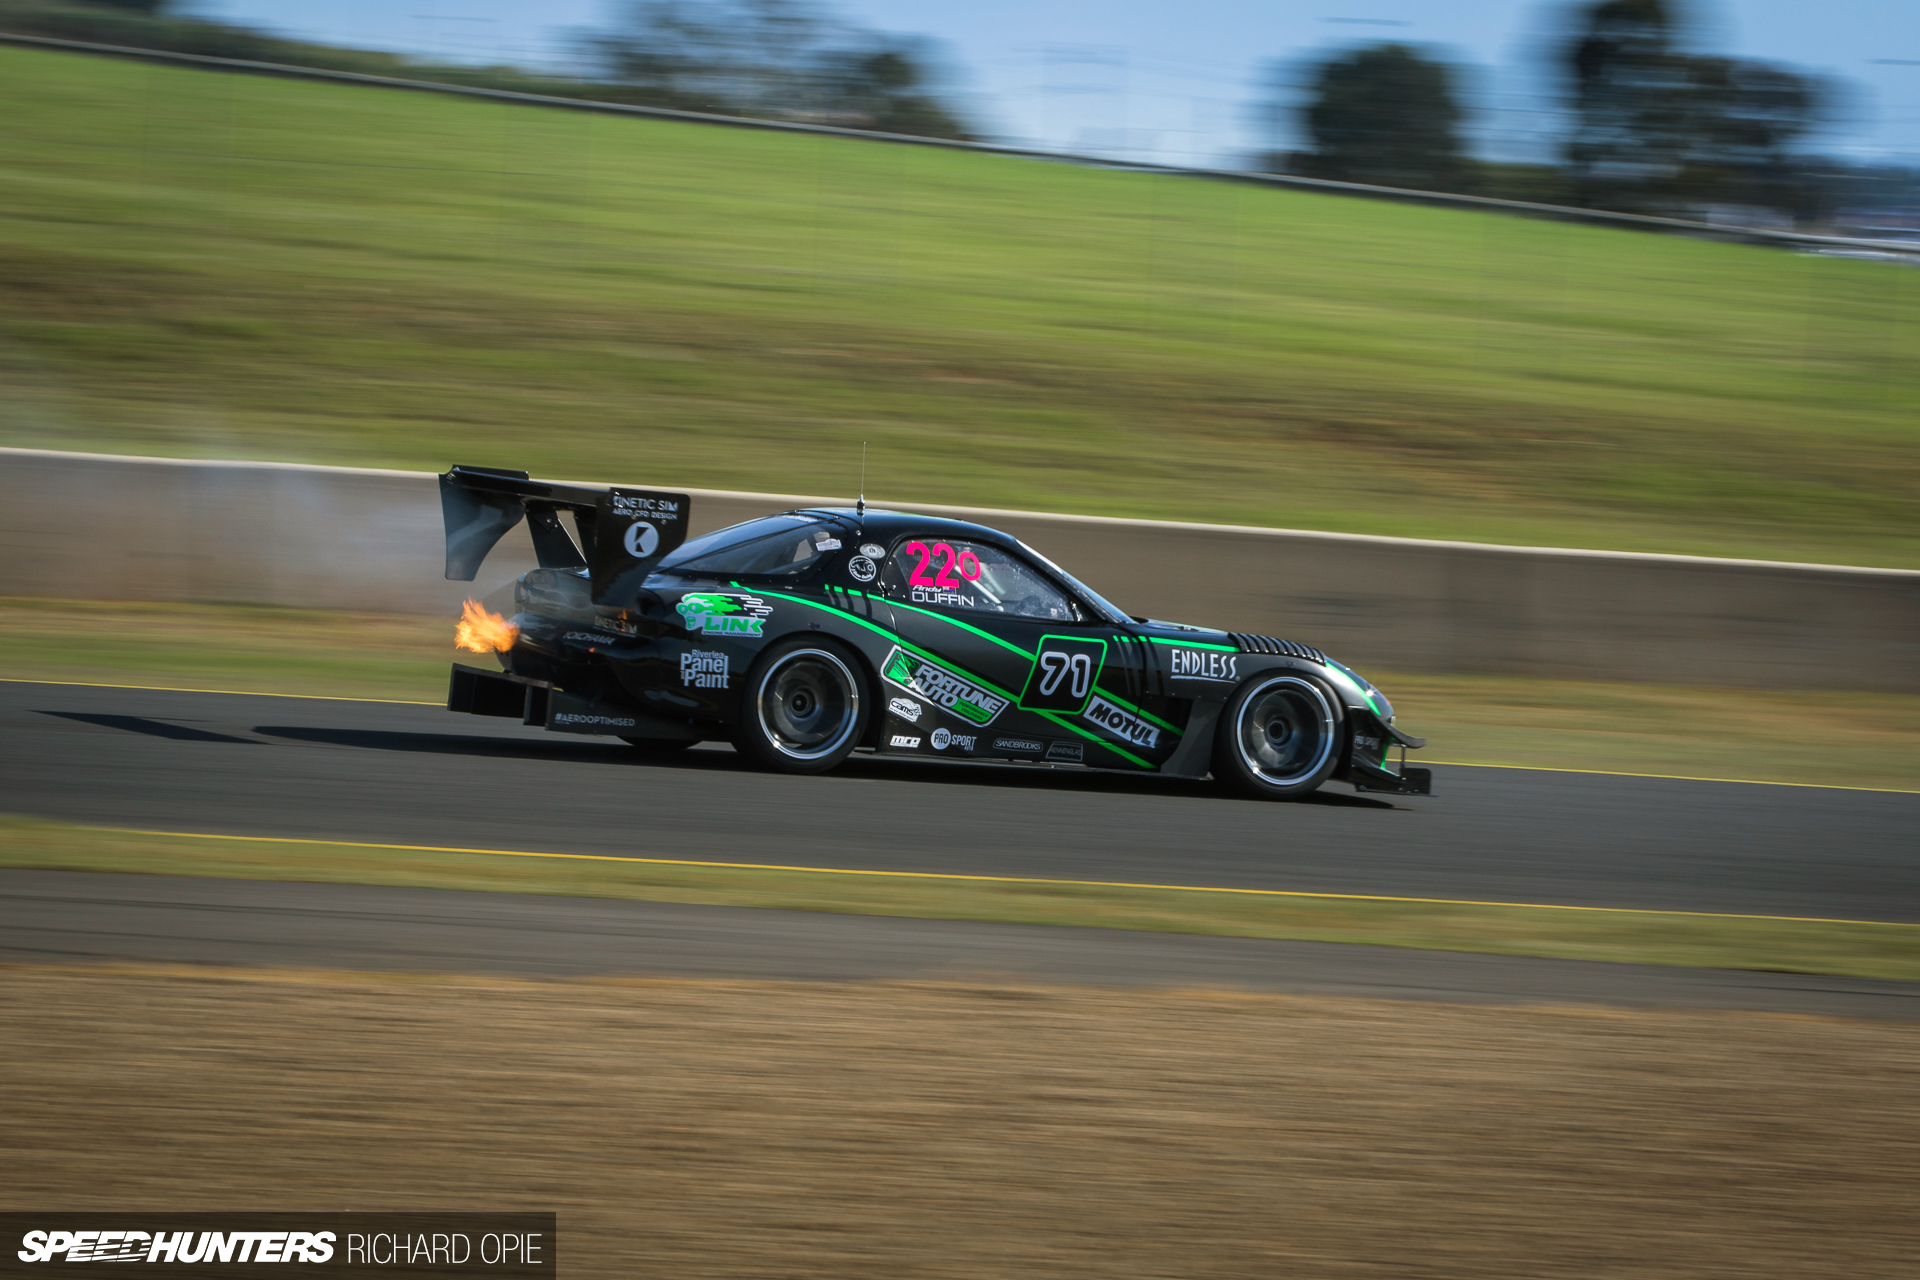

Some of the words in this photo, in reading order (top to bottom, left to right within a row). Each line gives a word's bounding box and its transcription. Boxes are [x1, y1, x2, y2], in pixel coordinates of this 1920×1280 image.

[612, 507, 633, 516] AERO
[651, 511, 678, 520] DESIGN
[657, 500, 678, 511] SIM
[911, 591, 974, 607] DUFFIN
[704, 616, 763, 633] LINK
[691, 649, 725, 660] Riverlea
[680, 653, 729, 677] Panel
[1171, 649, 1236, 679] ENDLESS
[683, 668, 730, 689] Paint
[1040, 651, 1091, 698] 71
[911, 677, 958, 708] AUTO
[915, 664, 1002, 714] FORTUNE
[555, 713, 636, 727] #AEROOPTIMISED
[1088, 702, 1154, 746] MOTUL
[934, 733, 949, 744] PRO
[951, 735, 977, 747] SPORT
[995, 740, 1041, 751] SANDBROOKS
